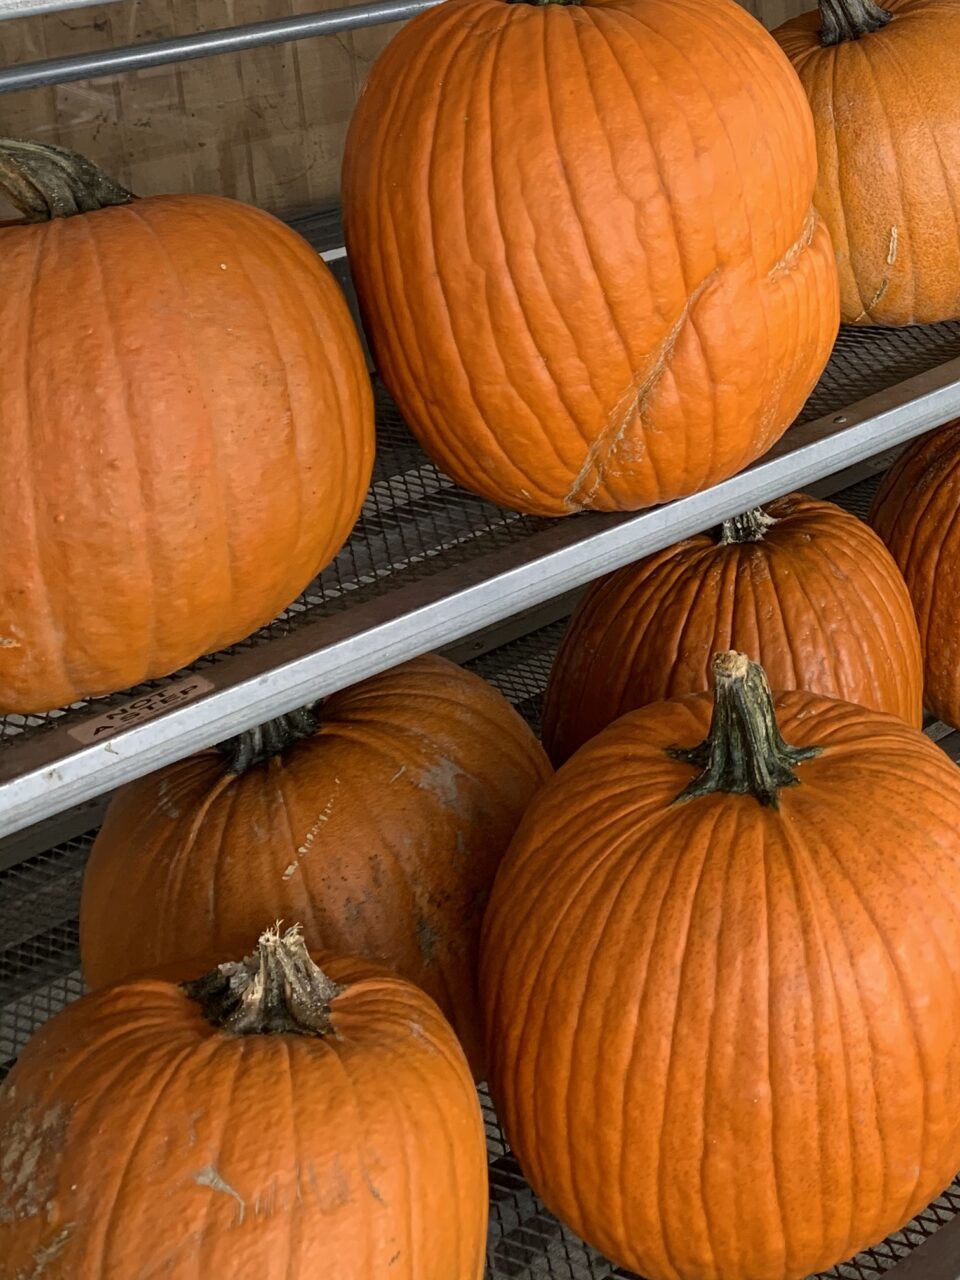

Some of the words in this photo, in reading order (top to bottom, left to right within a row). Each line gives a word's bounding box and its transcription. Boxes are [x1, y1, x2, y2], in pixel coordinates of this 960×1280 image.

[93, 725, 115, 737] A
[120, 684, 198, 721] STEP
[106, 689, 168, 720] NOT
